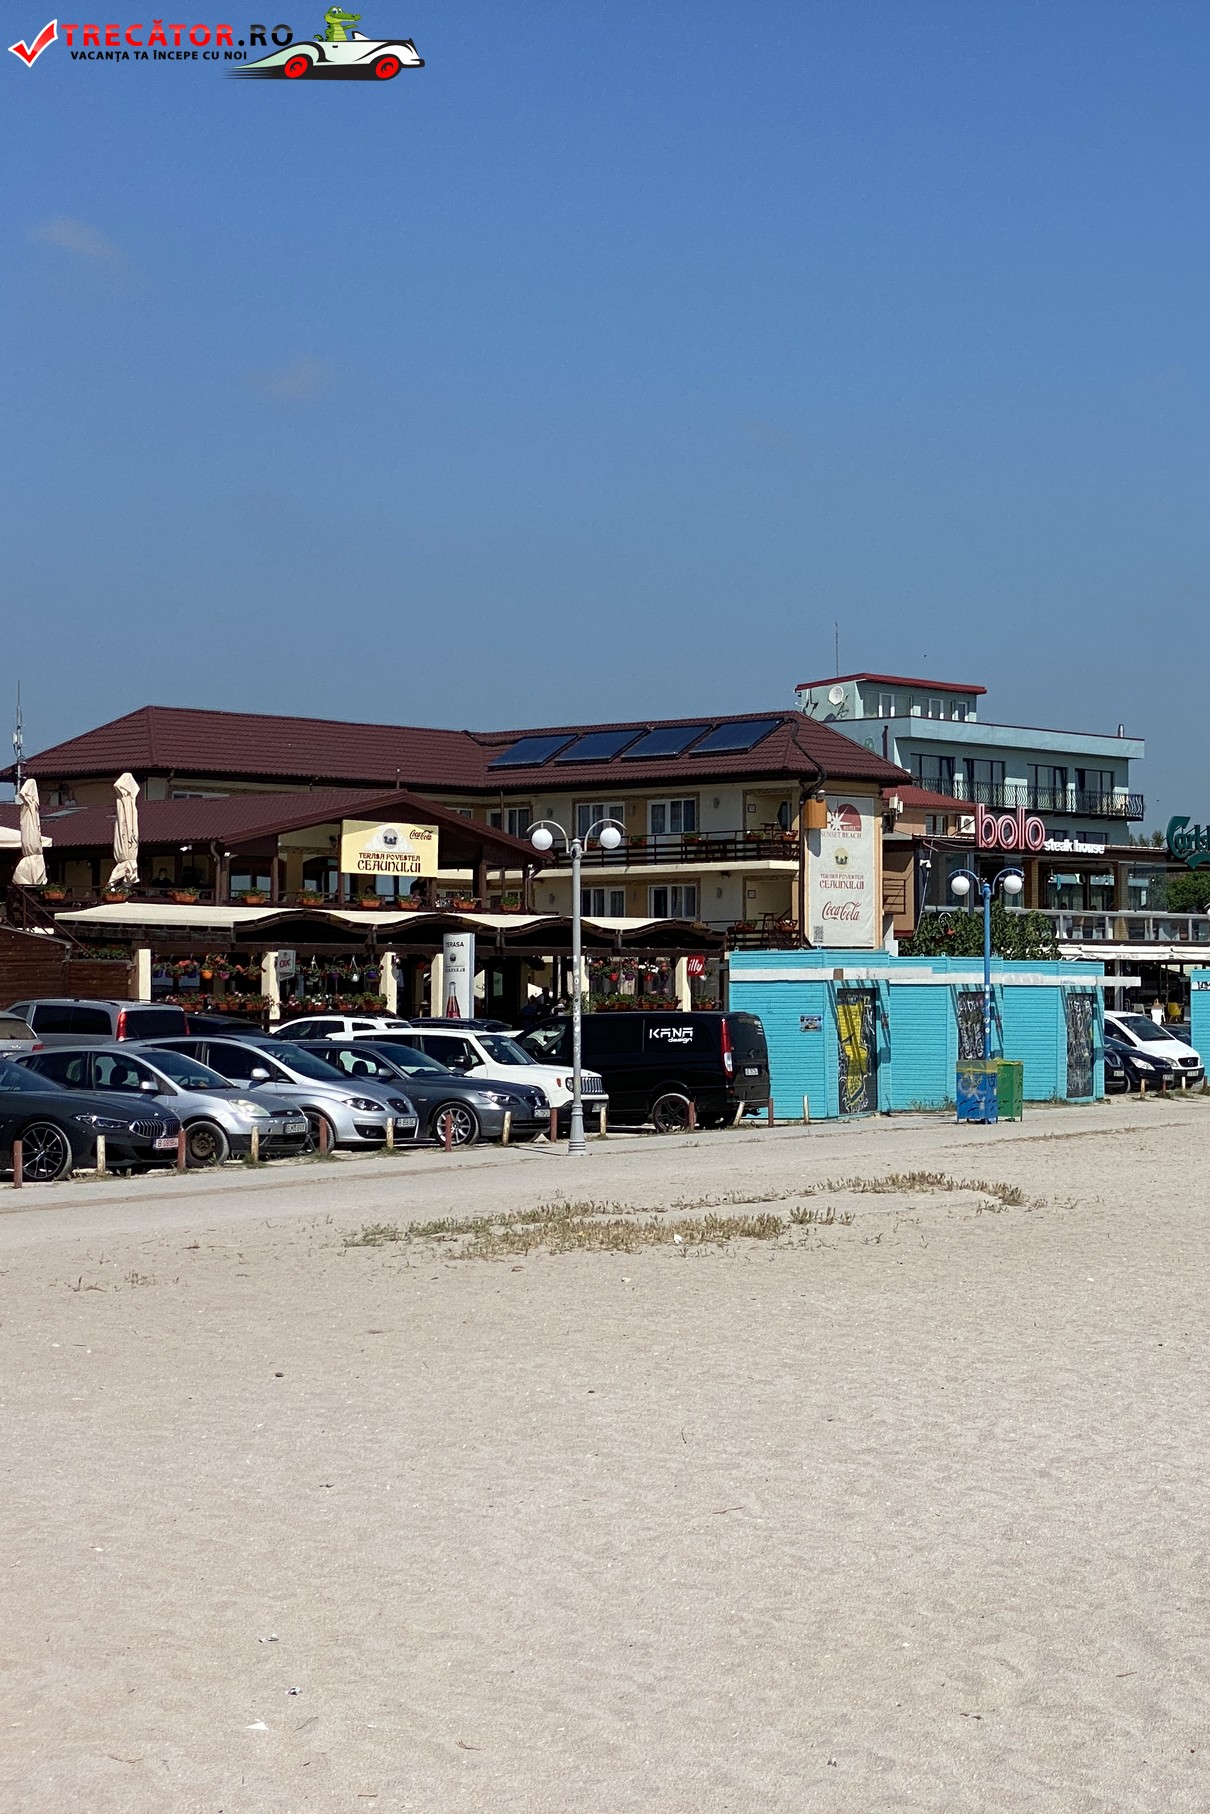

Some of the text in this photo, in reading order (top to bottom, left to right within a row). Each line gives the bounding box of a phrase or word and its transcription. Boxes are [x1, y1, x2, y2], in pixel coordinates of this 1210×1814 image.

[977, 803, 1105, 854] bolo steak house
[359, 852, 385, 860] TERASA
[357, 860, 421, 873] CEAUNULUI
[688, 959, 703, 974] illy
